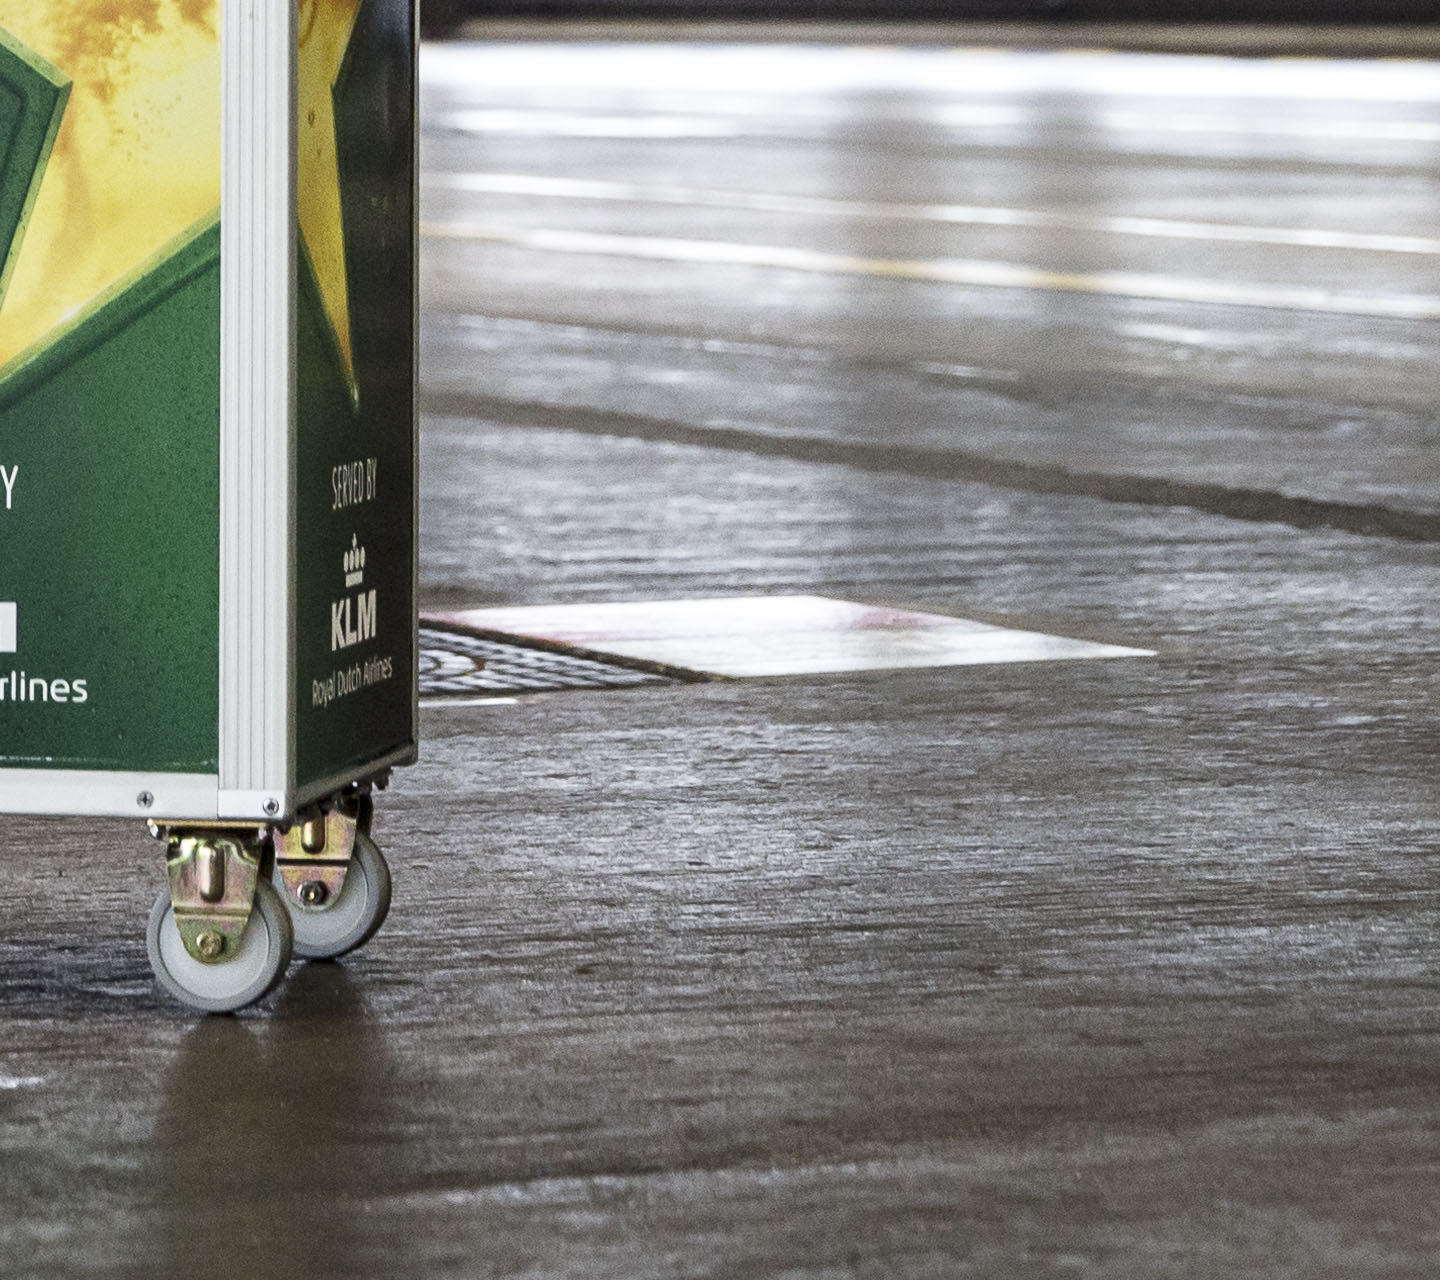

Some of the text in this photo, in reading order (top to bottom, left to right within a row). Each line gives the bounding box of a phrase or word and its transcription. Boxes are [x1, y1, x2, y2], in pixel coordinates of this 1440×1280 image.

[331, 457, 378, 511] SERVED BY
[331, 589, 377, 652] KLM
[312, 671, 336, 709] Royal
[337, 662, 362, 697] Dutch
